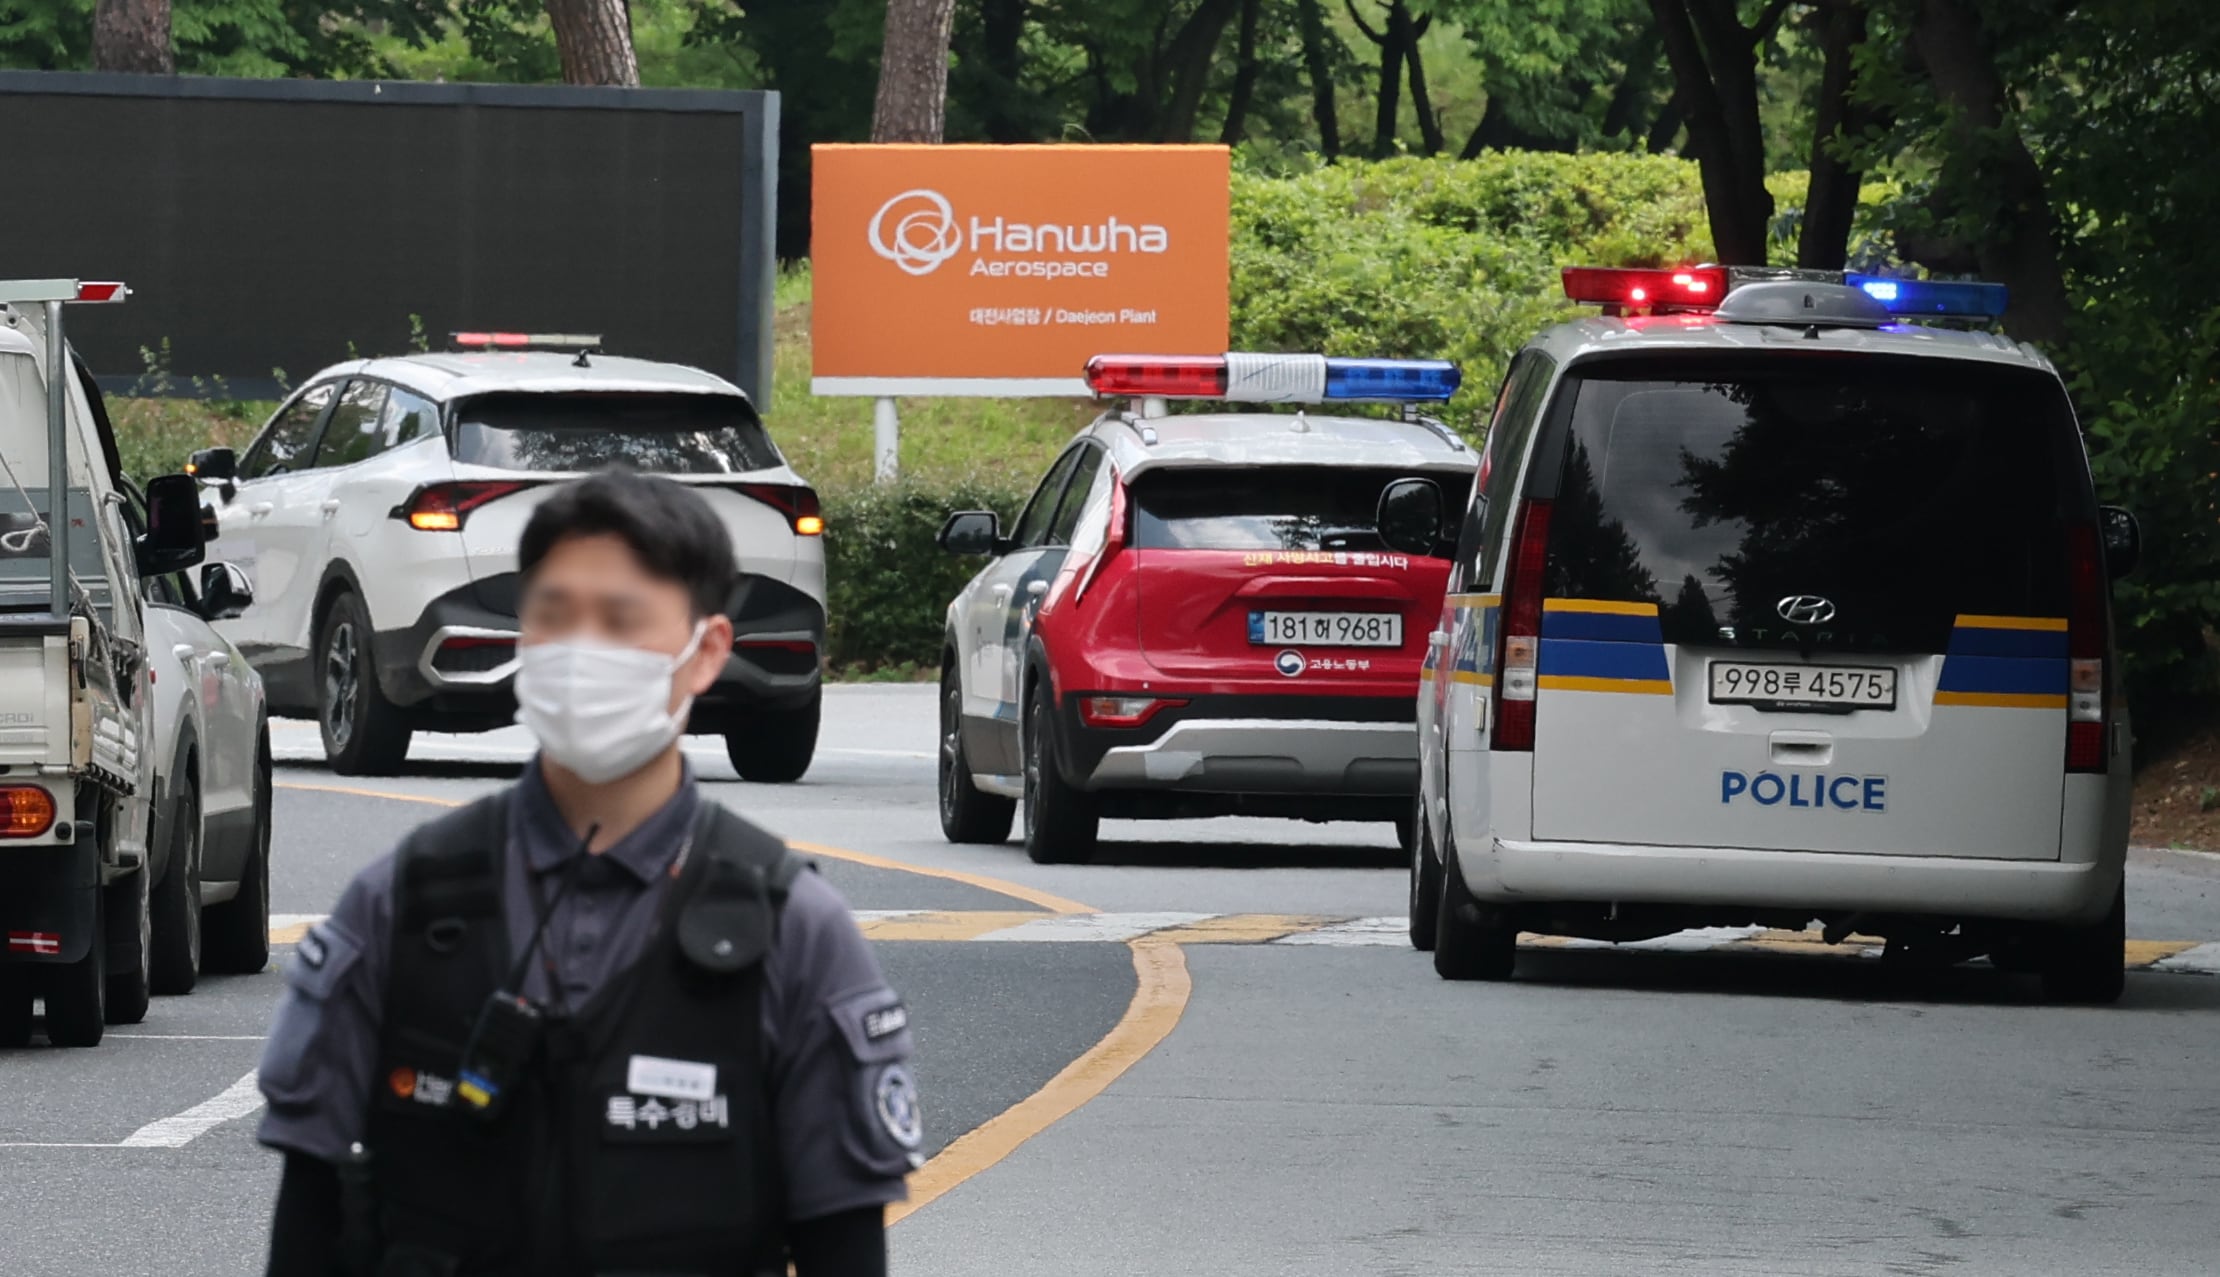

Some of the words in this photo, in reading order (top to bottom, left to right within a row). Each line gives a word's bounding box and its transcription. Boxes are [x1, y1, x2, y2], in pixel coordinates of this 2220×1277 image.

[969, 216, 1169, 253] Hanwha
[969, 257, 1109, 281] Aerospace
[969, 307, 1041, 325] 대전사업장
[1055, 308, 1116, 325] Daejeon
[1119, 308, 1157, 323] Plant
[1720, 770, 1886, 811] POLICE
